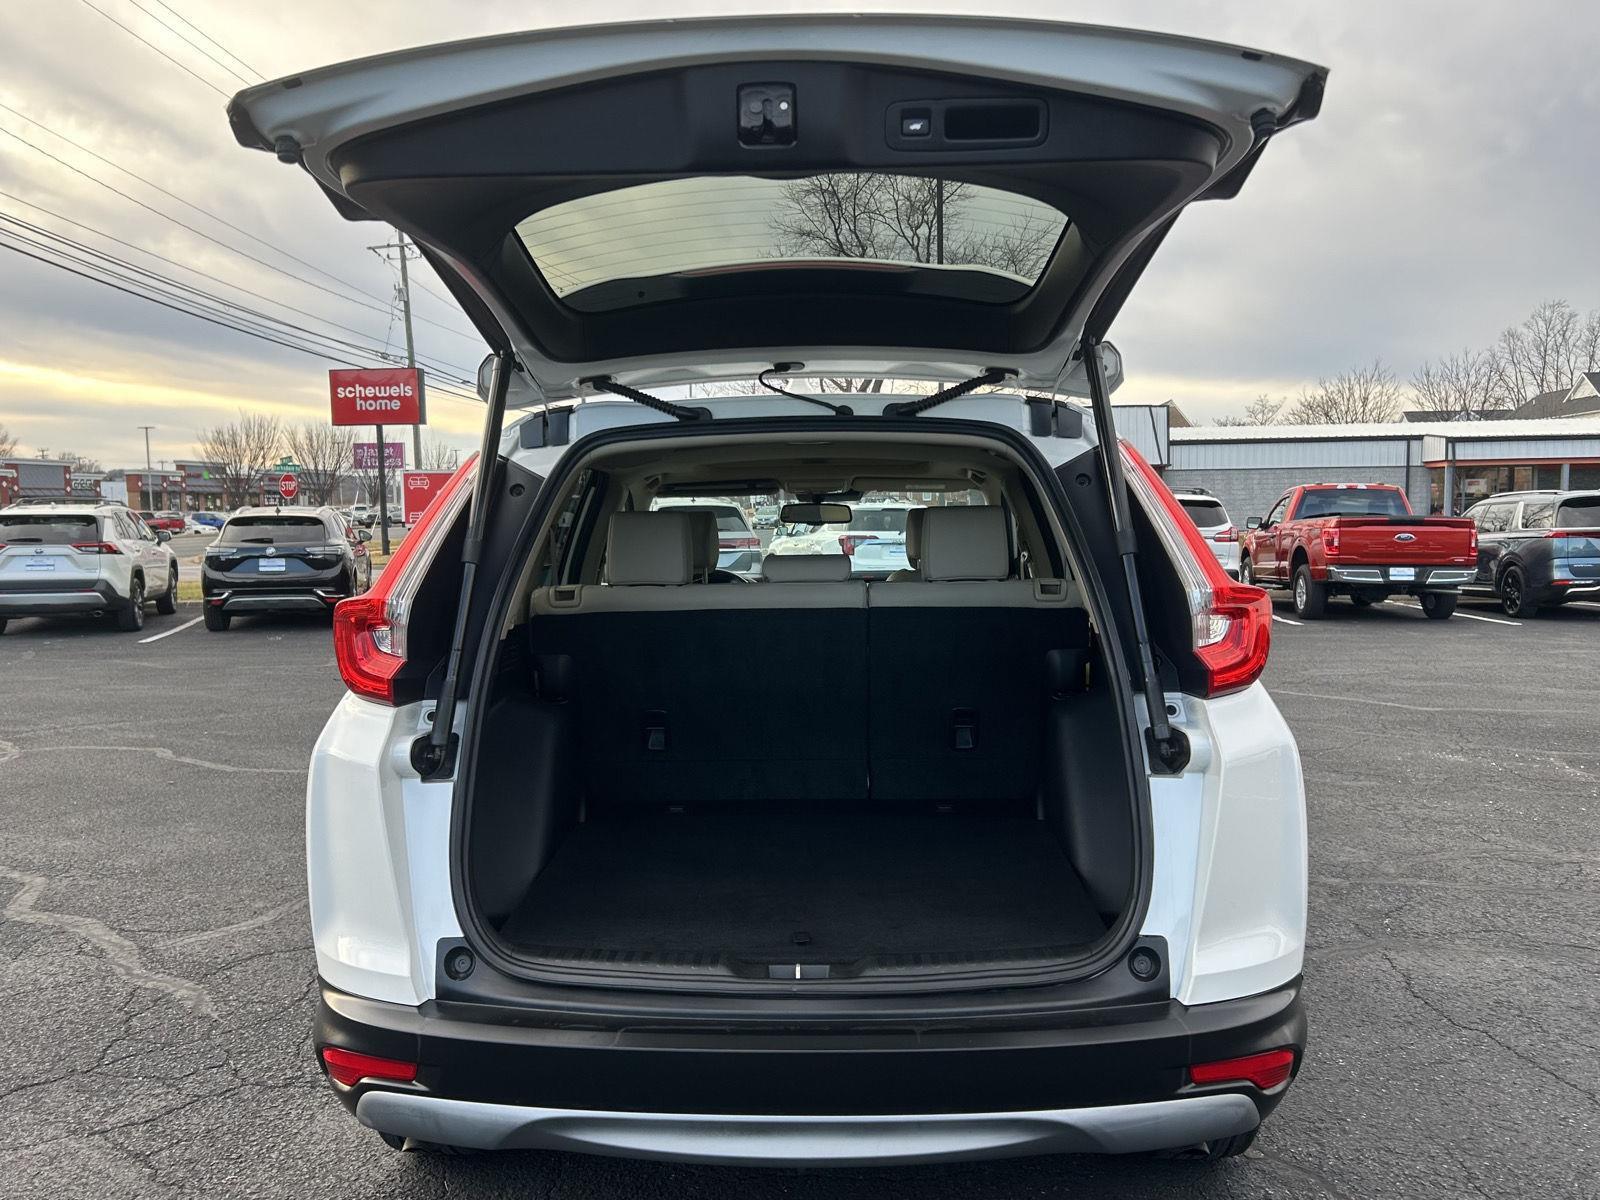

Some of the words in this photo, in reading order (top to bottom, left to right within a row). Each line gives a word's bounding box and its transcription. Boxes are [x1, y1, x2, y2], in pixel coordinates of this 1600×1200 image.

[337, 383, 413, 398] schewels
[356, 397, 401, 411] home
[281, 481, 296, 491] STOP
